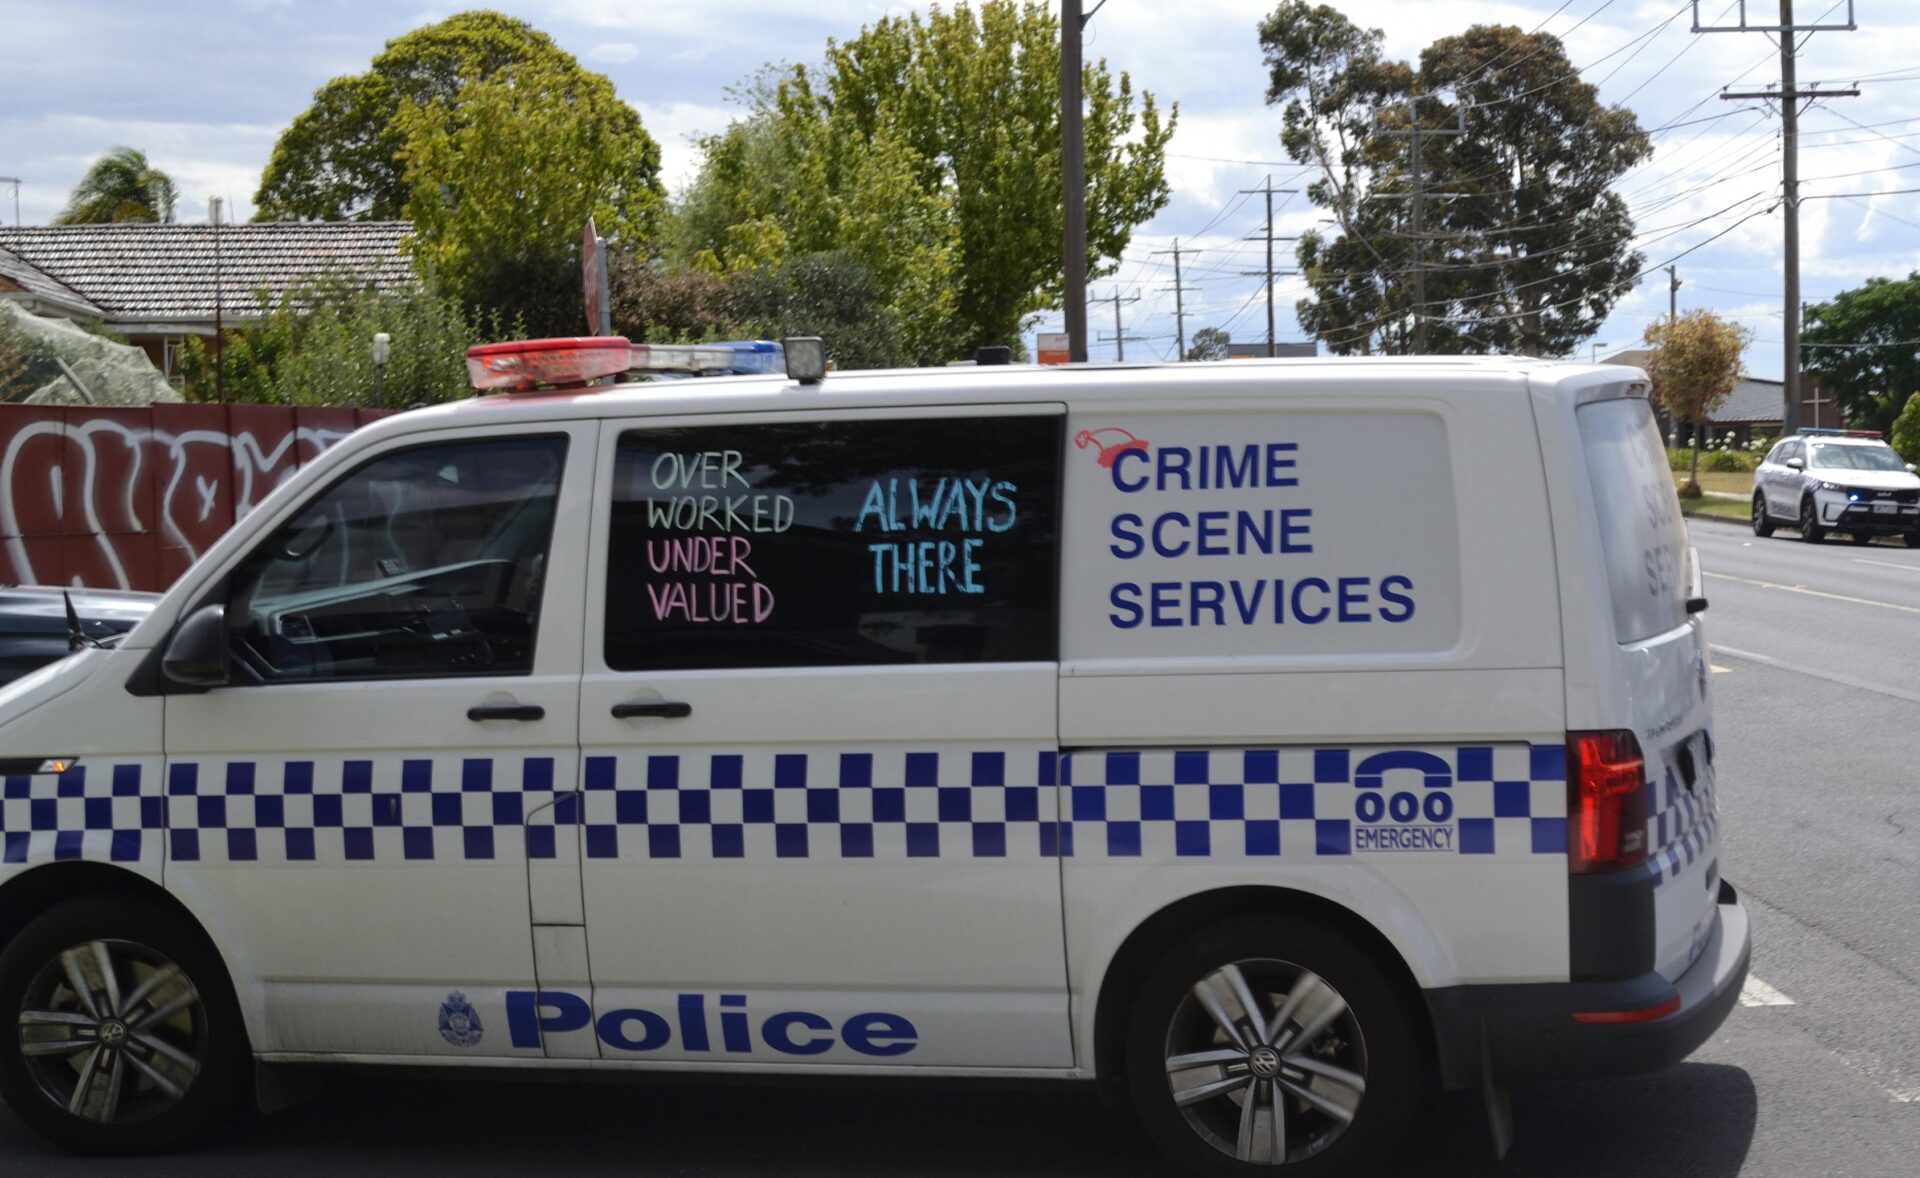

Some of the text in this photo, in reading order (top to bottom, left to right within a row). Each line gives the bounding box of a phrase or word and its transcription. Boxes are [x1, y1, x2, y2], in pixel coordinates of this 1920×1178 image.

[650, 449, 750, 490] OVER
[1111, 442, 1299, 493] CRIME
[646, 494, 795, 533] WORKED
[854, 477, 1018, 533] ALWAYS
[646, 535, 757, 578] UNDER
[1109, 508, 1314, 560] SCENE
[868, 539, 985, 594] THERE
[646, 582, 775, 623] VALUED
[1109, 575, 1416, 629] SERVICES
[1355, 828, 1453, 849] EMERGENCY
[505, 991, 918, 1056] Police
